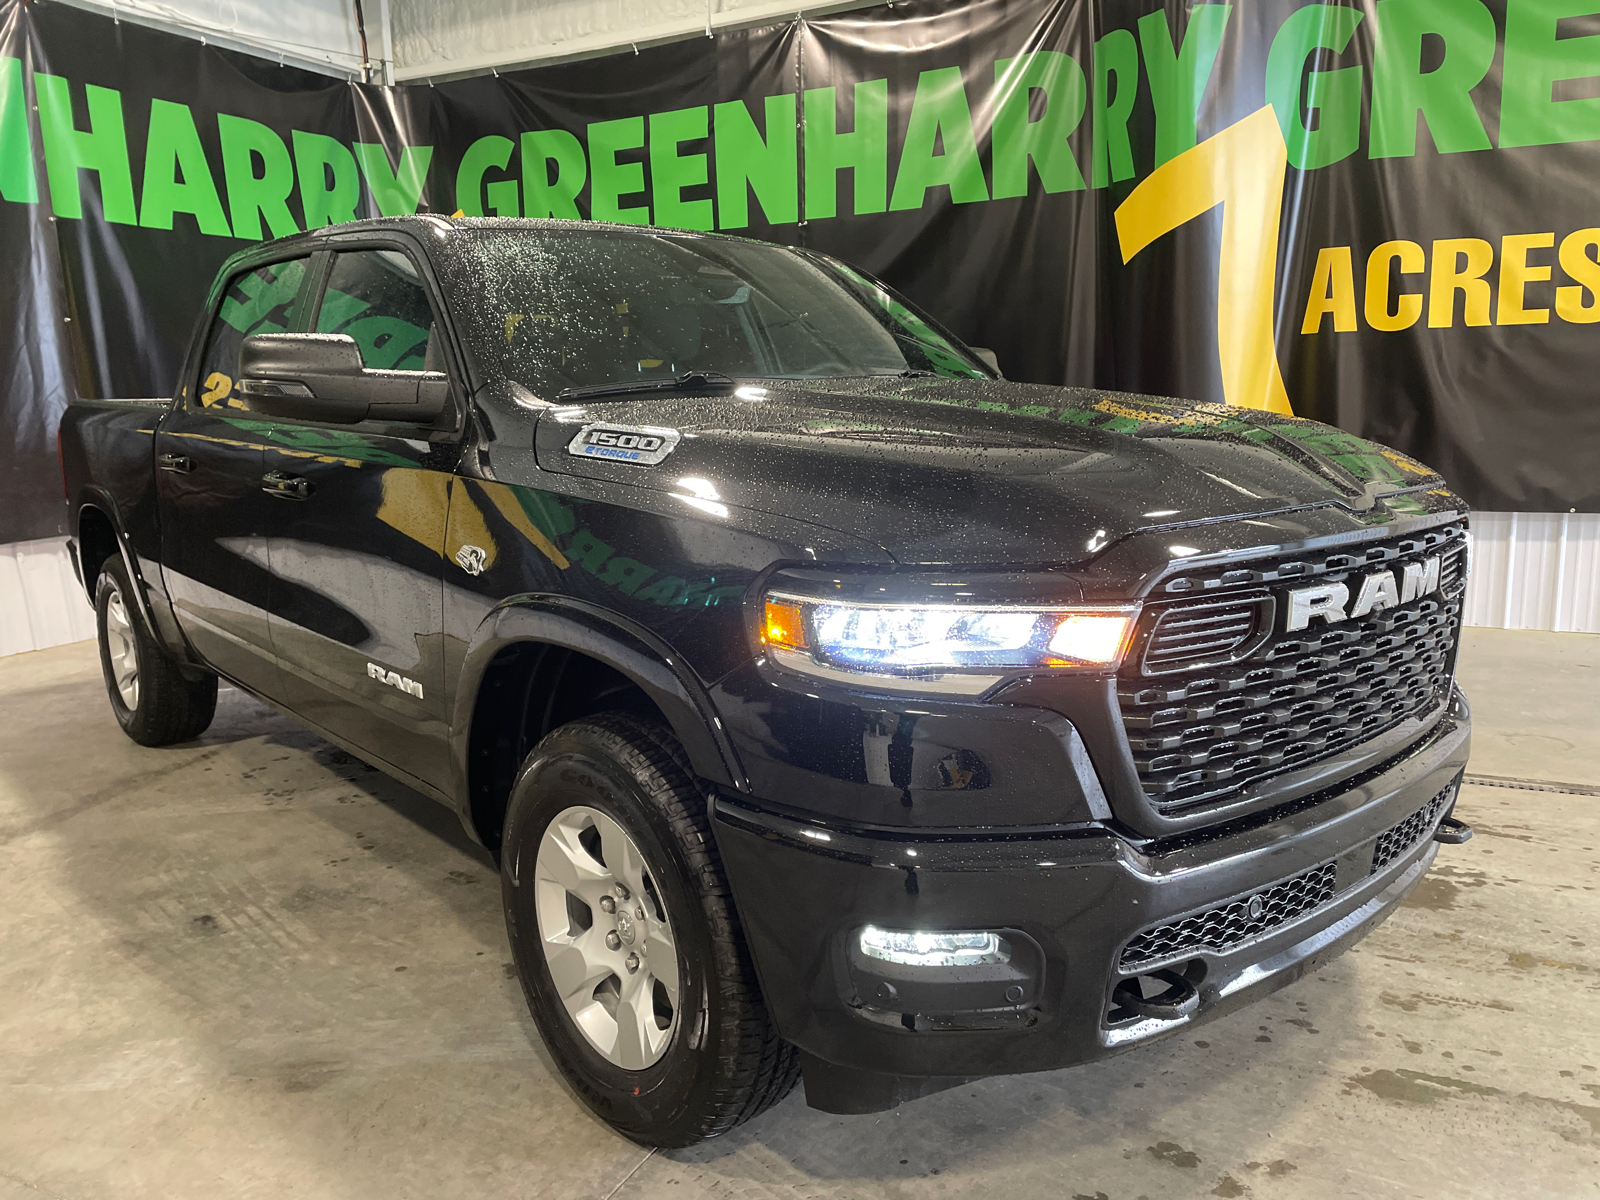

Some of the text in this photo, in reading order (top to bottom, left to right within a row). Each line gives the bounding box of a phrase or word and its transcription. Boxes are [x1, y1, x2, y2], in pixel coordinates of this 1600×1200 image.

[34, 72, 434, 241] HARRY
[455, 93, 799, 231] GREEN
[802, 4, 1232, 220] HARRY
[1301, 227, 1600, 334] ACRES
[588, 431, 662, 451] 1500
[1286, 555, 1441, 632] RAM
[366, 661, 424, 700] RAM
